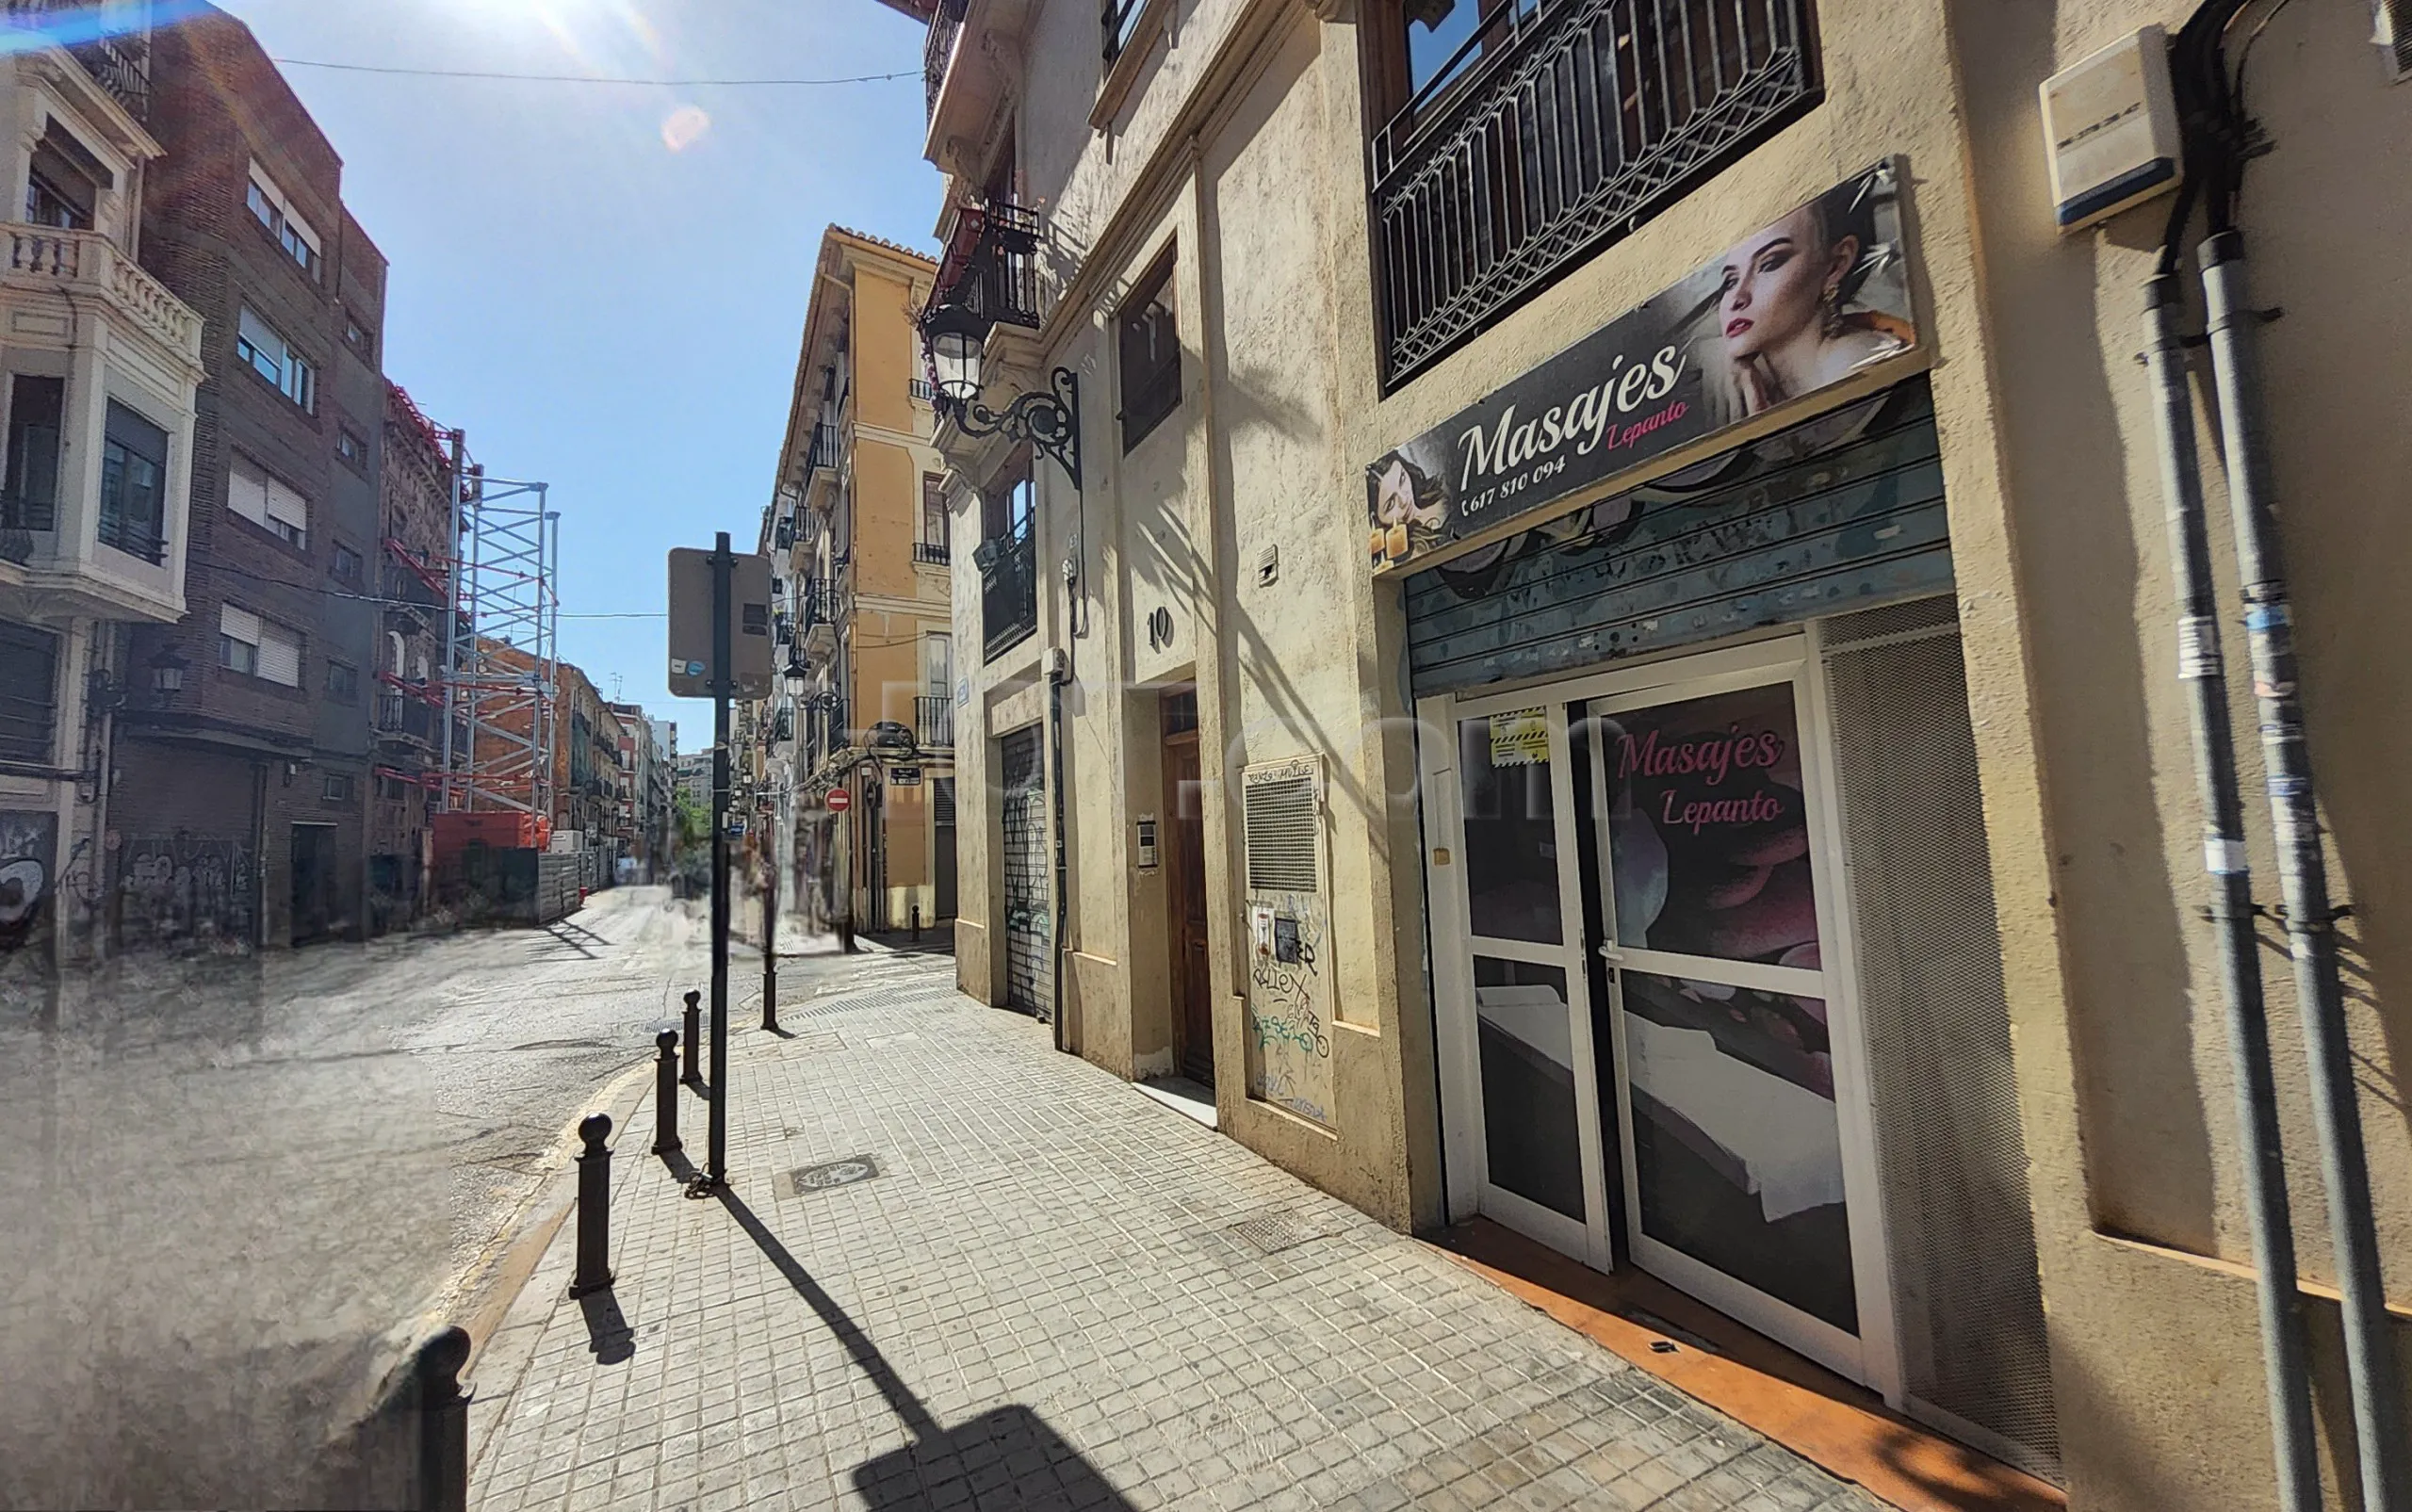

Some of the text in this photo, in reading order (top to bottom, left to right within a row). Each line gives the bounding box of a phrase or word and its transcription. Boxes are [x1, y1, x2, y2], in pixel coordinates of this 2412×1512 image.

[1458, 345, 1687, 492] Masajes
[1605, 399, 1689, 450] Lepanto
[1470, 454, 1566, 512] 617 810 094
[1147, 606, 1170, 647] 10
[1615, 724, 1786, 786] Masajes
[1660, 789, 1785, 836] Lepanto
